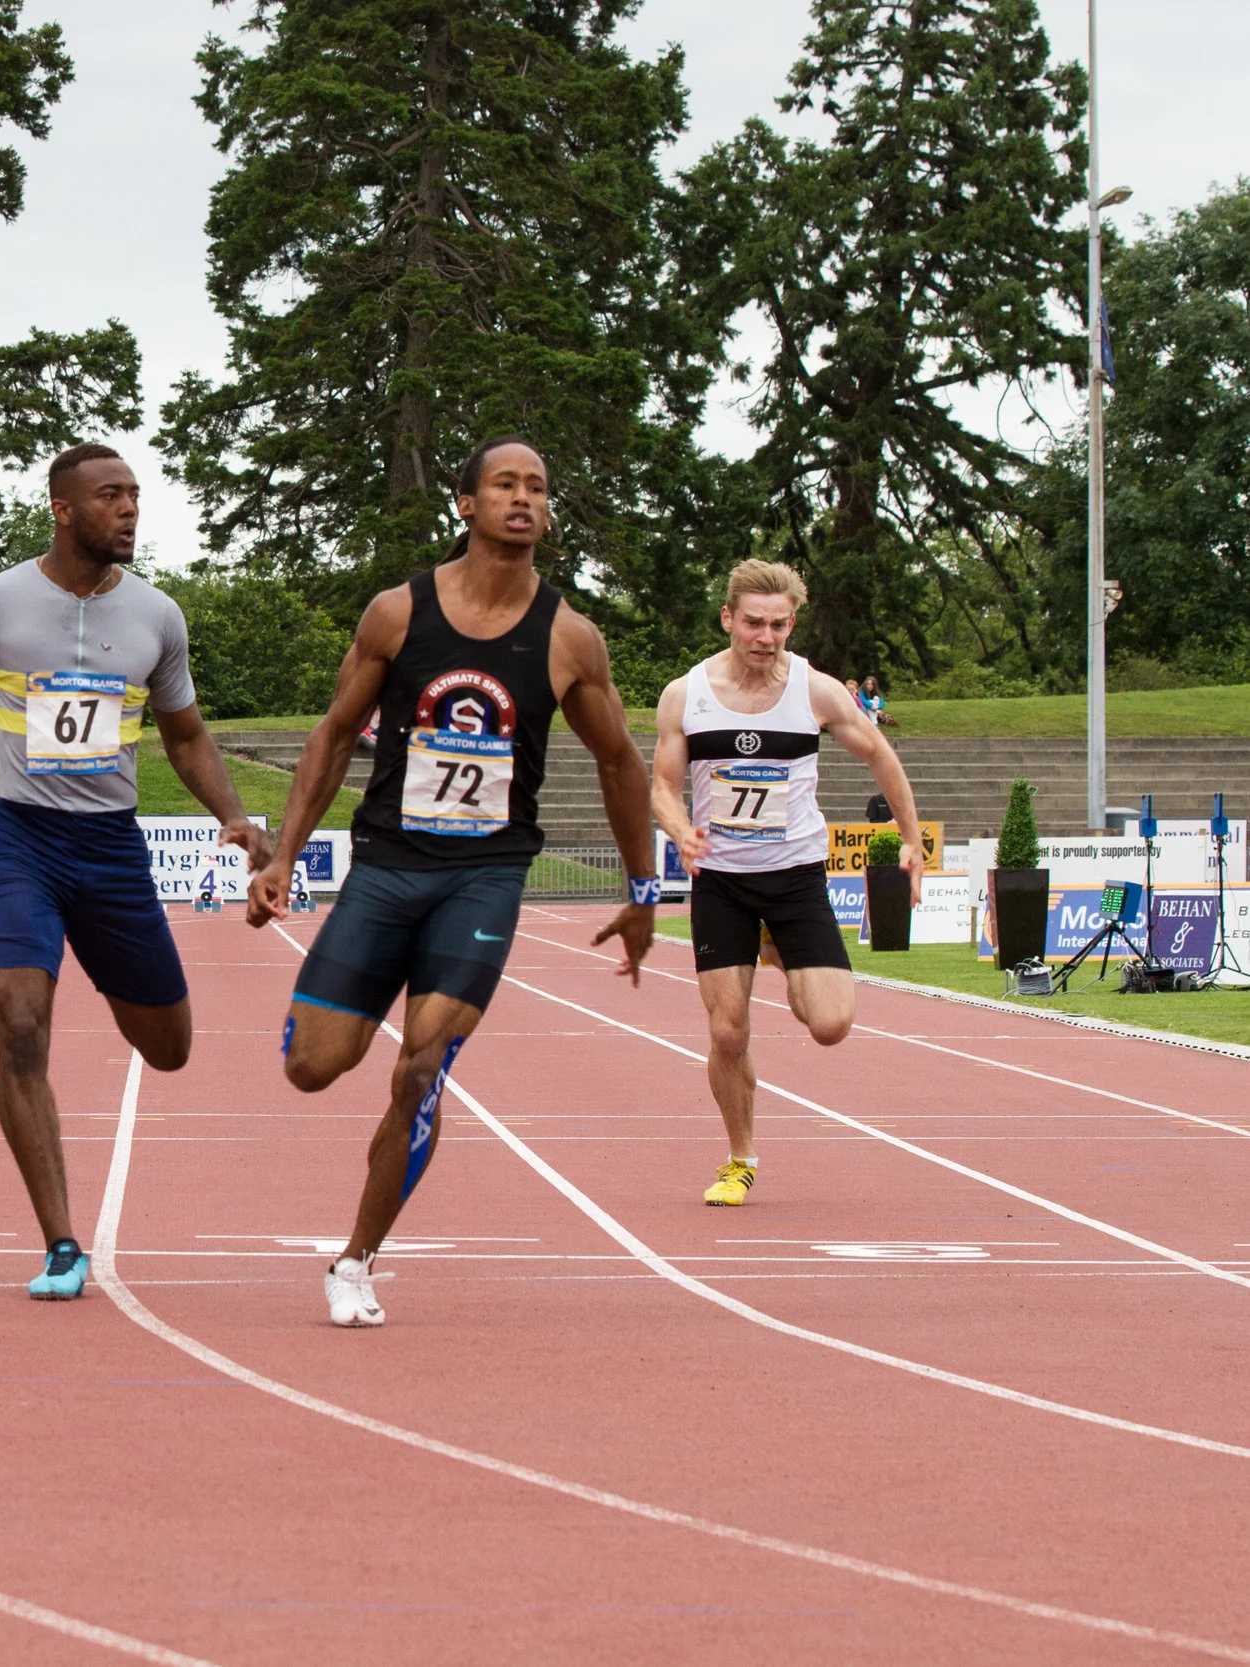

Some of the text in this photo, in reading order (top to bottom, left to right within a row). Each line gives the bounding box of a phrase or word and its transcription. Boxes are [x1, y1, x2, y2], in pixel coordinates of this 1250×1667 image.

[50, 676, 125, 690] MORTON GAMES
[428, 673, 510, 711] ULTIMATE SPEED
[53, 698, 100, 744] 67
[433, 736, 512, 751] MORTON GAMES
[432, 760, 484, 807] 72
[729, 769, 761, 777] MORTON
[730, 786, 770, 819] 77
[149, 849, 239, 872] Hygine
[1052, 845, 1060, 857] is
[1063, 845, 1099, 859] proudly
[1101, 845, 1148, 859] supported
[199, 869, 218, 895] 4
[1158, 900, 1213, 918] BEHAN
